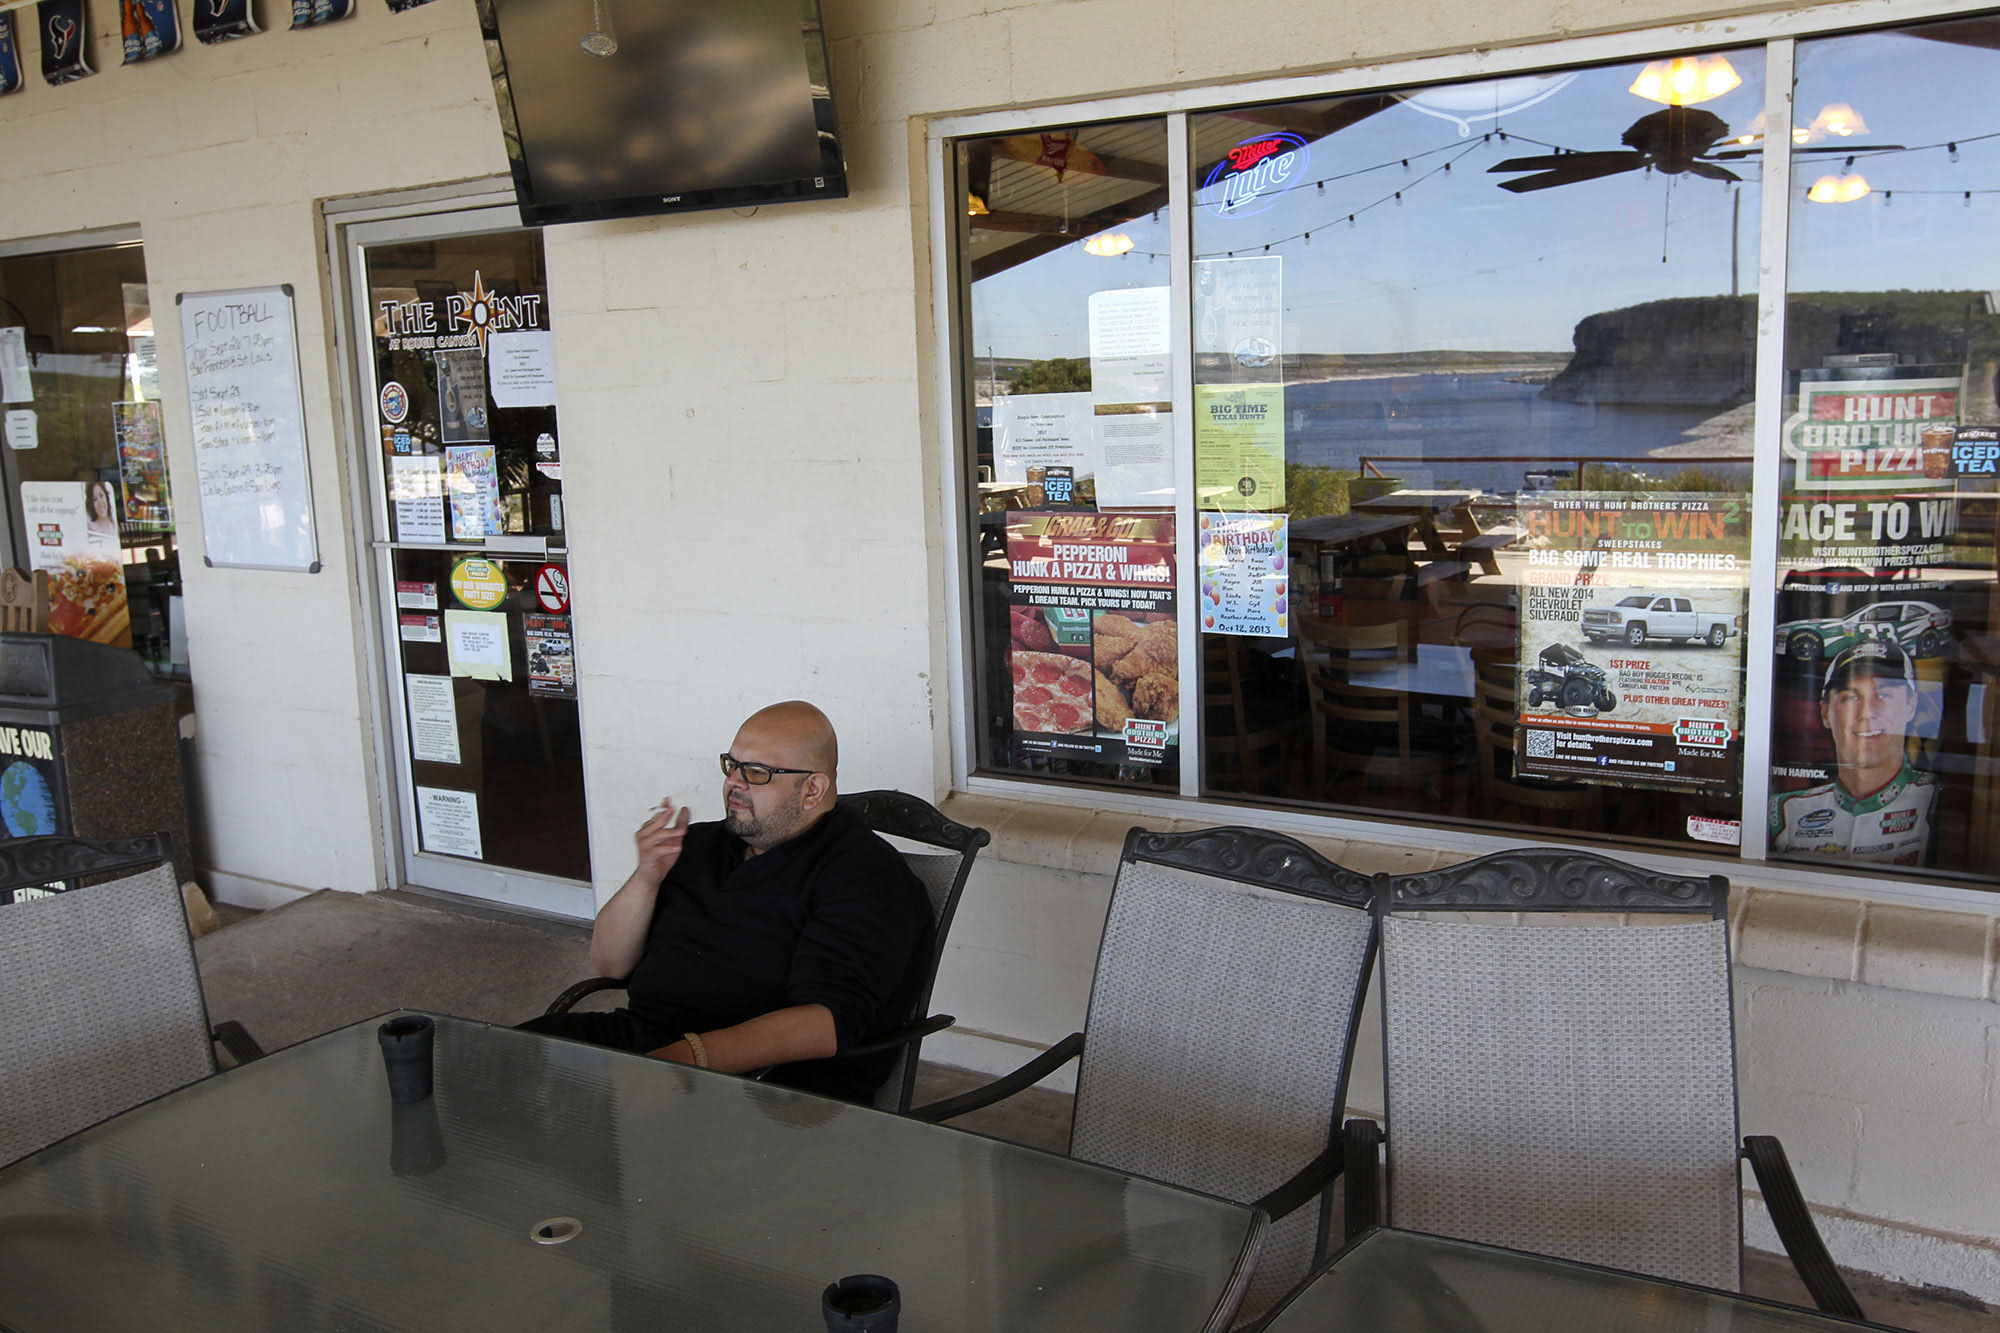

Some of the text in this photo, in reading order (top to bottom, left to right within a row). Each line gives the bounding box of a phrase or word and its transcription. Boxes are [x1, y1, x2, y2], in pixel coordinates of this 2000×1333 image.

[1228, 139, 1283, 170] Miller
[1218, 151, 1296, 213] Lite
[194, 302, 273, 339] FOOTBALL
[380, 295, 541, 334] THE POINT
[389, 334, 477, 350] AT ROUGH CANYON
[1210, 404, 1268, 414] BIG TIME
[1844, 395, 1936, 422] HUNT
[394, 436, 411, 445] ICED
[395, 444, 410, 453] TEA
[1952, 447, 2000, 459] ICED
[456, 450, 478, 462] HAPPY
[454, 459, 489, 472] BIRTHDAY
[1955, 460, 1996, 472] TEA
[1045, 481, 1072, 491] ICED
[1047, 491, 1070, 501] TEA
[1553, 501, 1583, 510] ENTER
[1585, 501, 1601, 510] THE
[1604, 501, 1628, 510] HUNT
[1682, 502, 1709, 511] PIZZA
[1045, 516, 1135, 538] GRAB & GO
[1529, 502, 1741, 540] HUNT TO WIN 2
[1867, 502, 1910, 540] TO
[1213, 530, 1275, 546] BIRTHDAY
[1598, 540, 1662, 549] SWEEPSTAKES
[1813, 543, 1944, 557] VISIT HUNTBROTHERSPIZZA.COM
[1053, 545, 1128, 563] PEPPERONI
[1529, 550, 1741, 571] BAG SOME REAL TROPHIES.
[1780, 557, 1791, 565] TO
[1793, 557, 1824, 567] LEARN
[1825, 557, 1849, 567] HOW
[1850, 558, 1861, 566] TO
[1865, 558, 1882, 566] WIN
[1884, 556, 1914, 566] PRIZES
[1915, 555, 1928, 565] ALL
[1013, 561, 1049, 577] HUNK
[1051, 563, 1060, 577] A
[1105, 565, 1116, 580] &
[1120, 565, 1171, 582] WINGS!
[1529, 572, 1610, 586] GRAND PRIZE
[1014, 585, 1050, 594] PEPPERONI
[1051, 586, 1069, 596] HUNK
[1070, 587, 1075, 596] A
[1097, 588, 1102, 597] &
[1104, 589, 1129, 598] WINGS!
[1131, 590, 1147, 599] NOW
[1149, 591, 1172, 600] THAT'S
[1529, 587, 1594, 600] ALL NEW 2014
[1792, 583, 1826, 592] FACEBOOK
[1840, 584, 1853, 592] AND
[1854, 584, 1870, 592] KEEP
[1871, 584, 1879, 592] UP
[1029, 595, 1034, 603] A
[1035, 596, 1058, 605] DREAM
[1081, 598, 1097, 607] PICK
[1099, 599, 1120, 608] YOURS
[1121, 600, 1131, 608] UP
[1132, 600, 1156, 610] TODAY!
[1529, 598, 1583, 610] CHEVROLET
[1529, 610, 1580, 622] SILVERADO
[1249, 625, 1271, 634] 2013
[1859, 623, 1898, 644] 33
[1609, 660, 1650, 670] 1ST PRIZE
[1624, 694, 1730, 709] PLUS OTHER GREAT PRIZES!
[1134, 723, 1156, 731] HUNT
[1688, 721, 1716, 730] HUNT
[1127, 729, 1165, 738] BROTHERS
[1677, 727, 1727, 738] BROTHERS
[20, 729, 54, 760] OUR
[1134, 736, 1157, 745] PIZZA
[1556, 731, 1653, 747] Visit huntbrotherspizza.com
[1556, 740, 1593, 750] for details.
[1687, 735, 1717, 744] PIZZA
[1678, 748, 1699, 757] Made
[1700, 750, 1710, 758] for
[1789, 768, 1829, 779] HARVICK.
[432, 795, 461, 804] WARNING
[1889, 811, 1911, 819] HUNT
[1889, 823, 1911, 833] PIZZA
